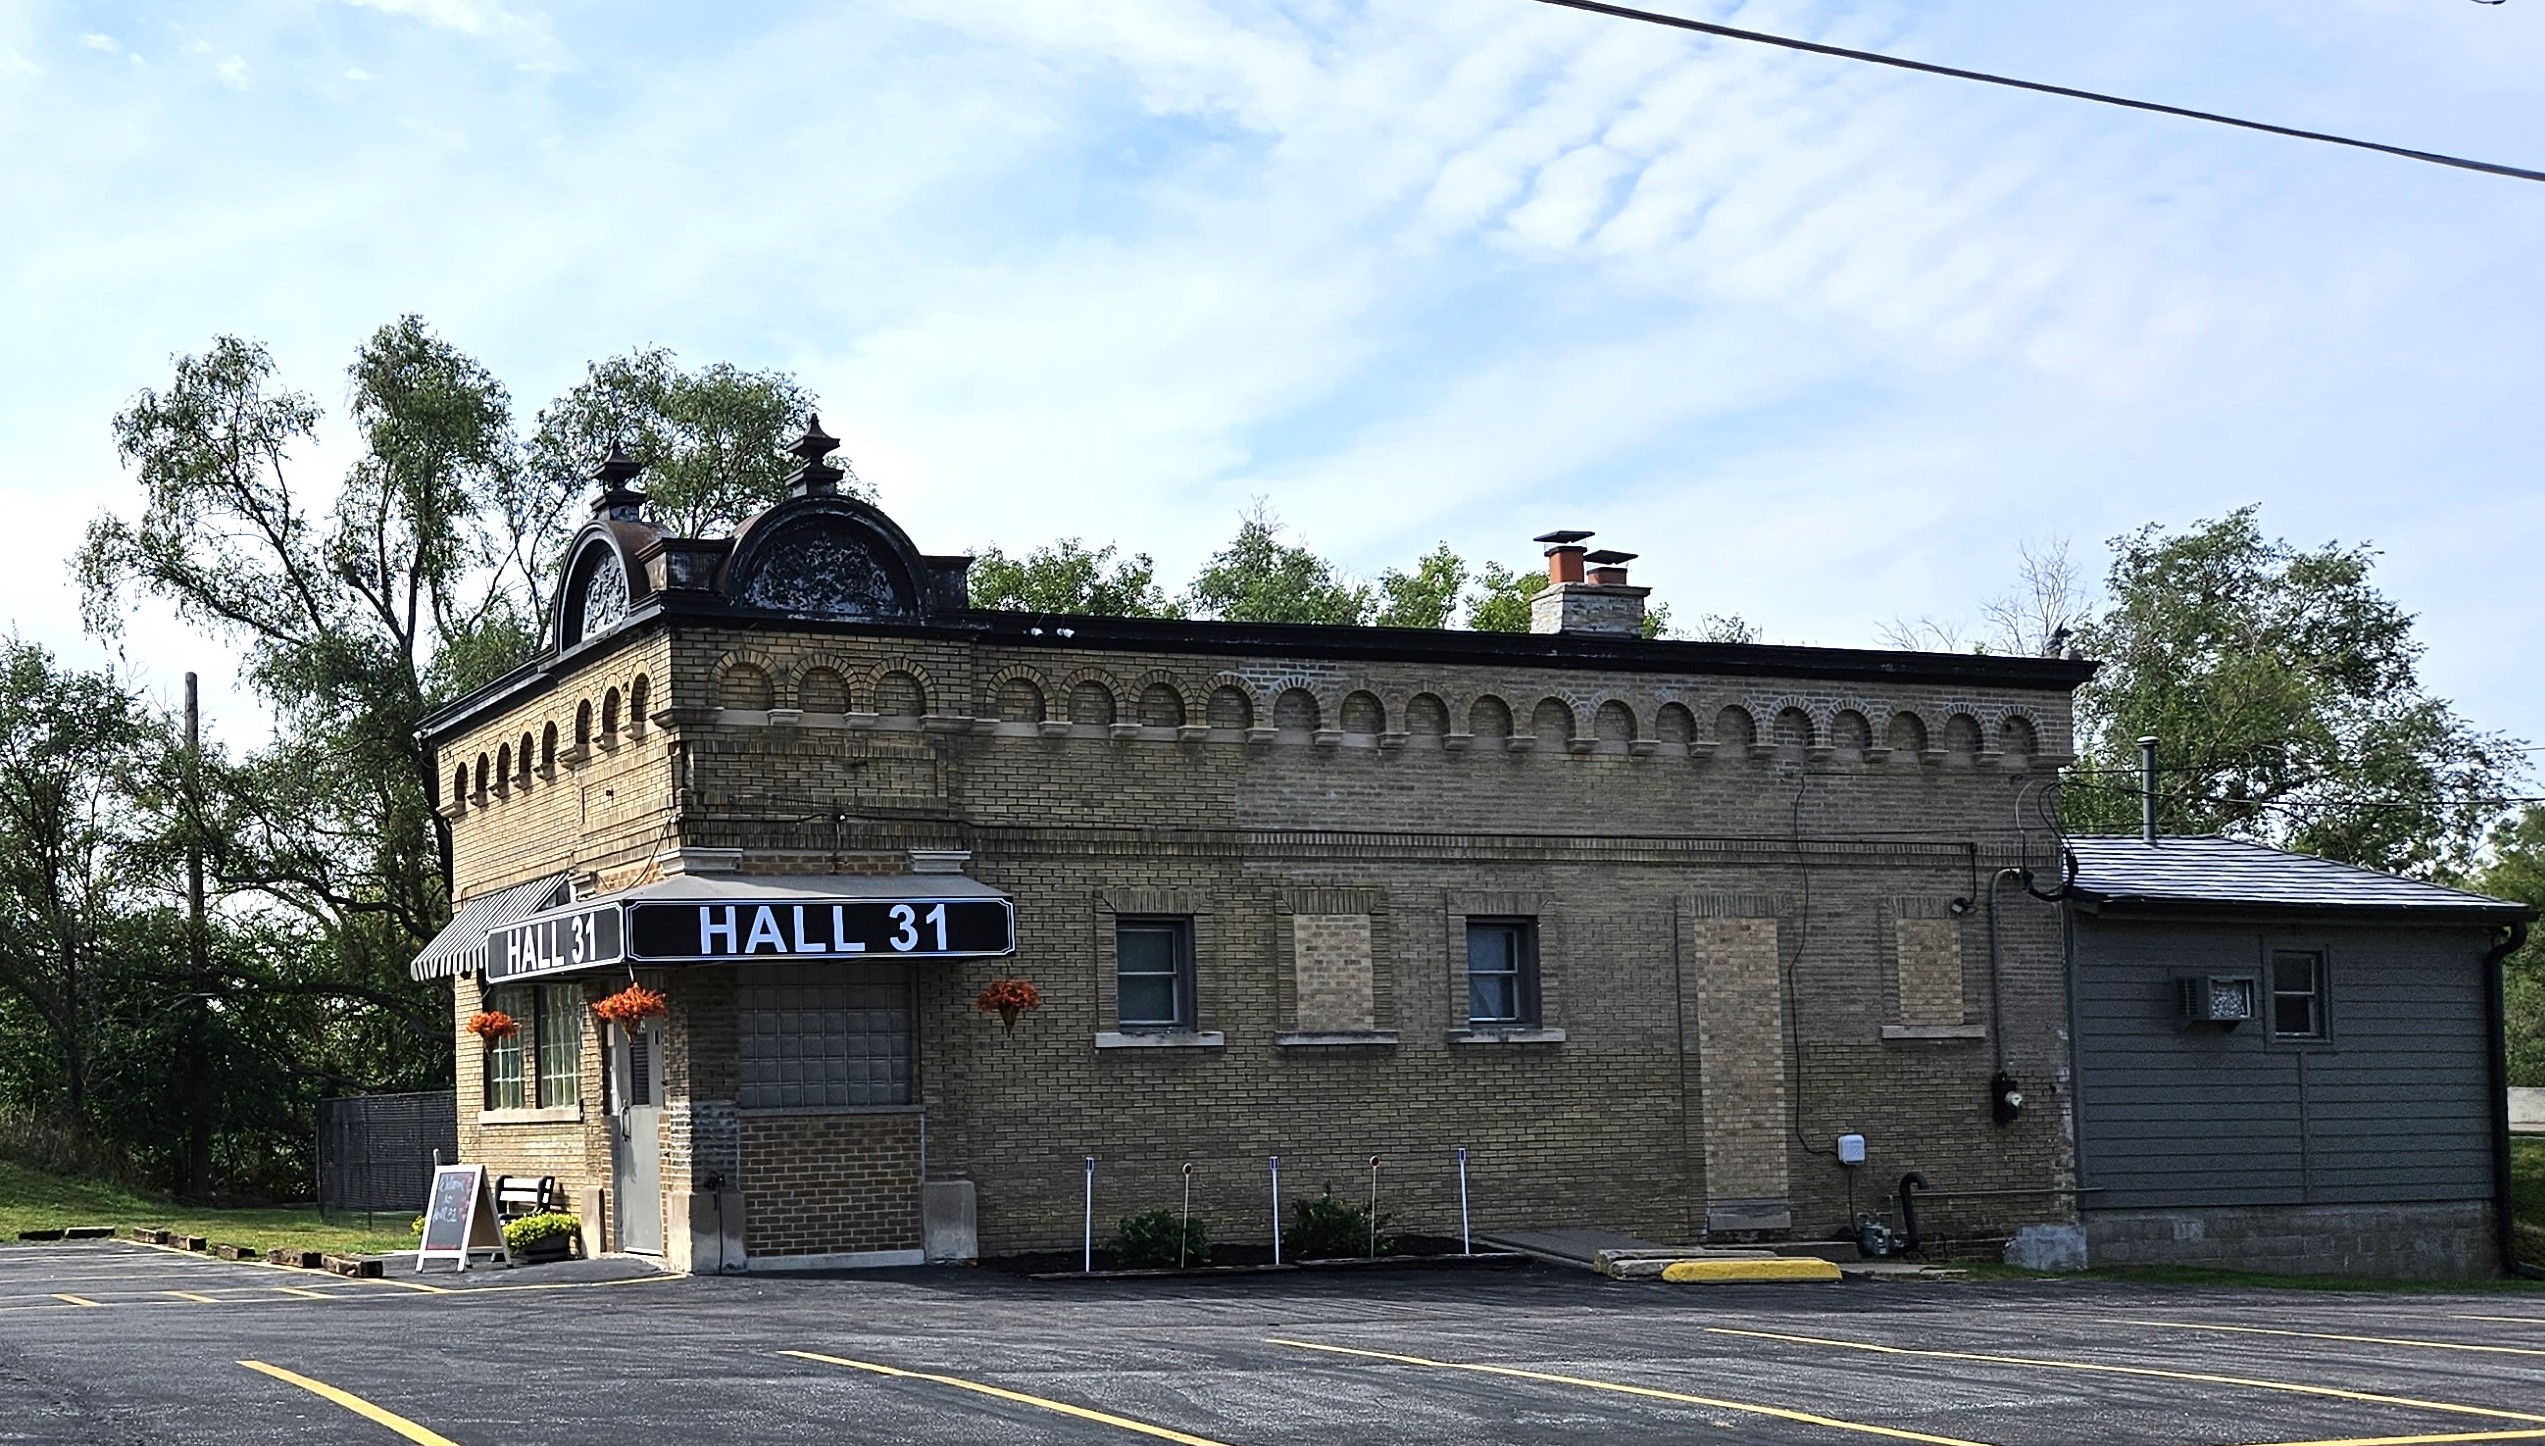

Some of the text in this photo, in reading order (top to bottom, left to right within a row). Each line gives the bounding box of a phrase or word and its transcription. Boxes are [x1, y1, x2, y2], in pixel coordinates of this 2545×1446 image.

[507, 912, 596, 975] HALL 31
[699, 904, 947, 955] HALL 31
